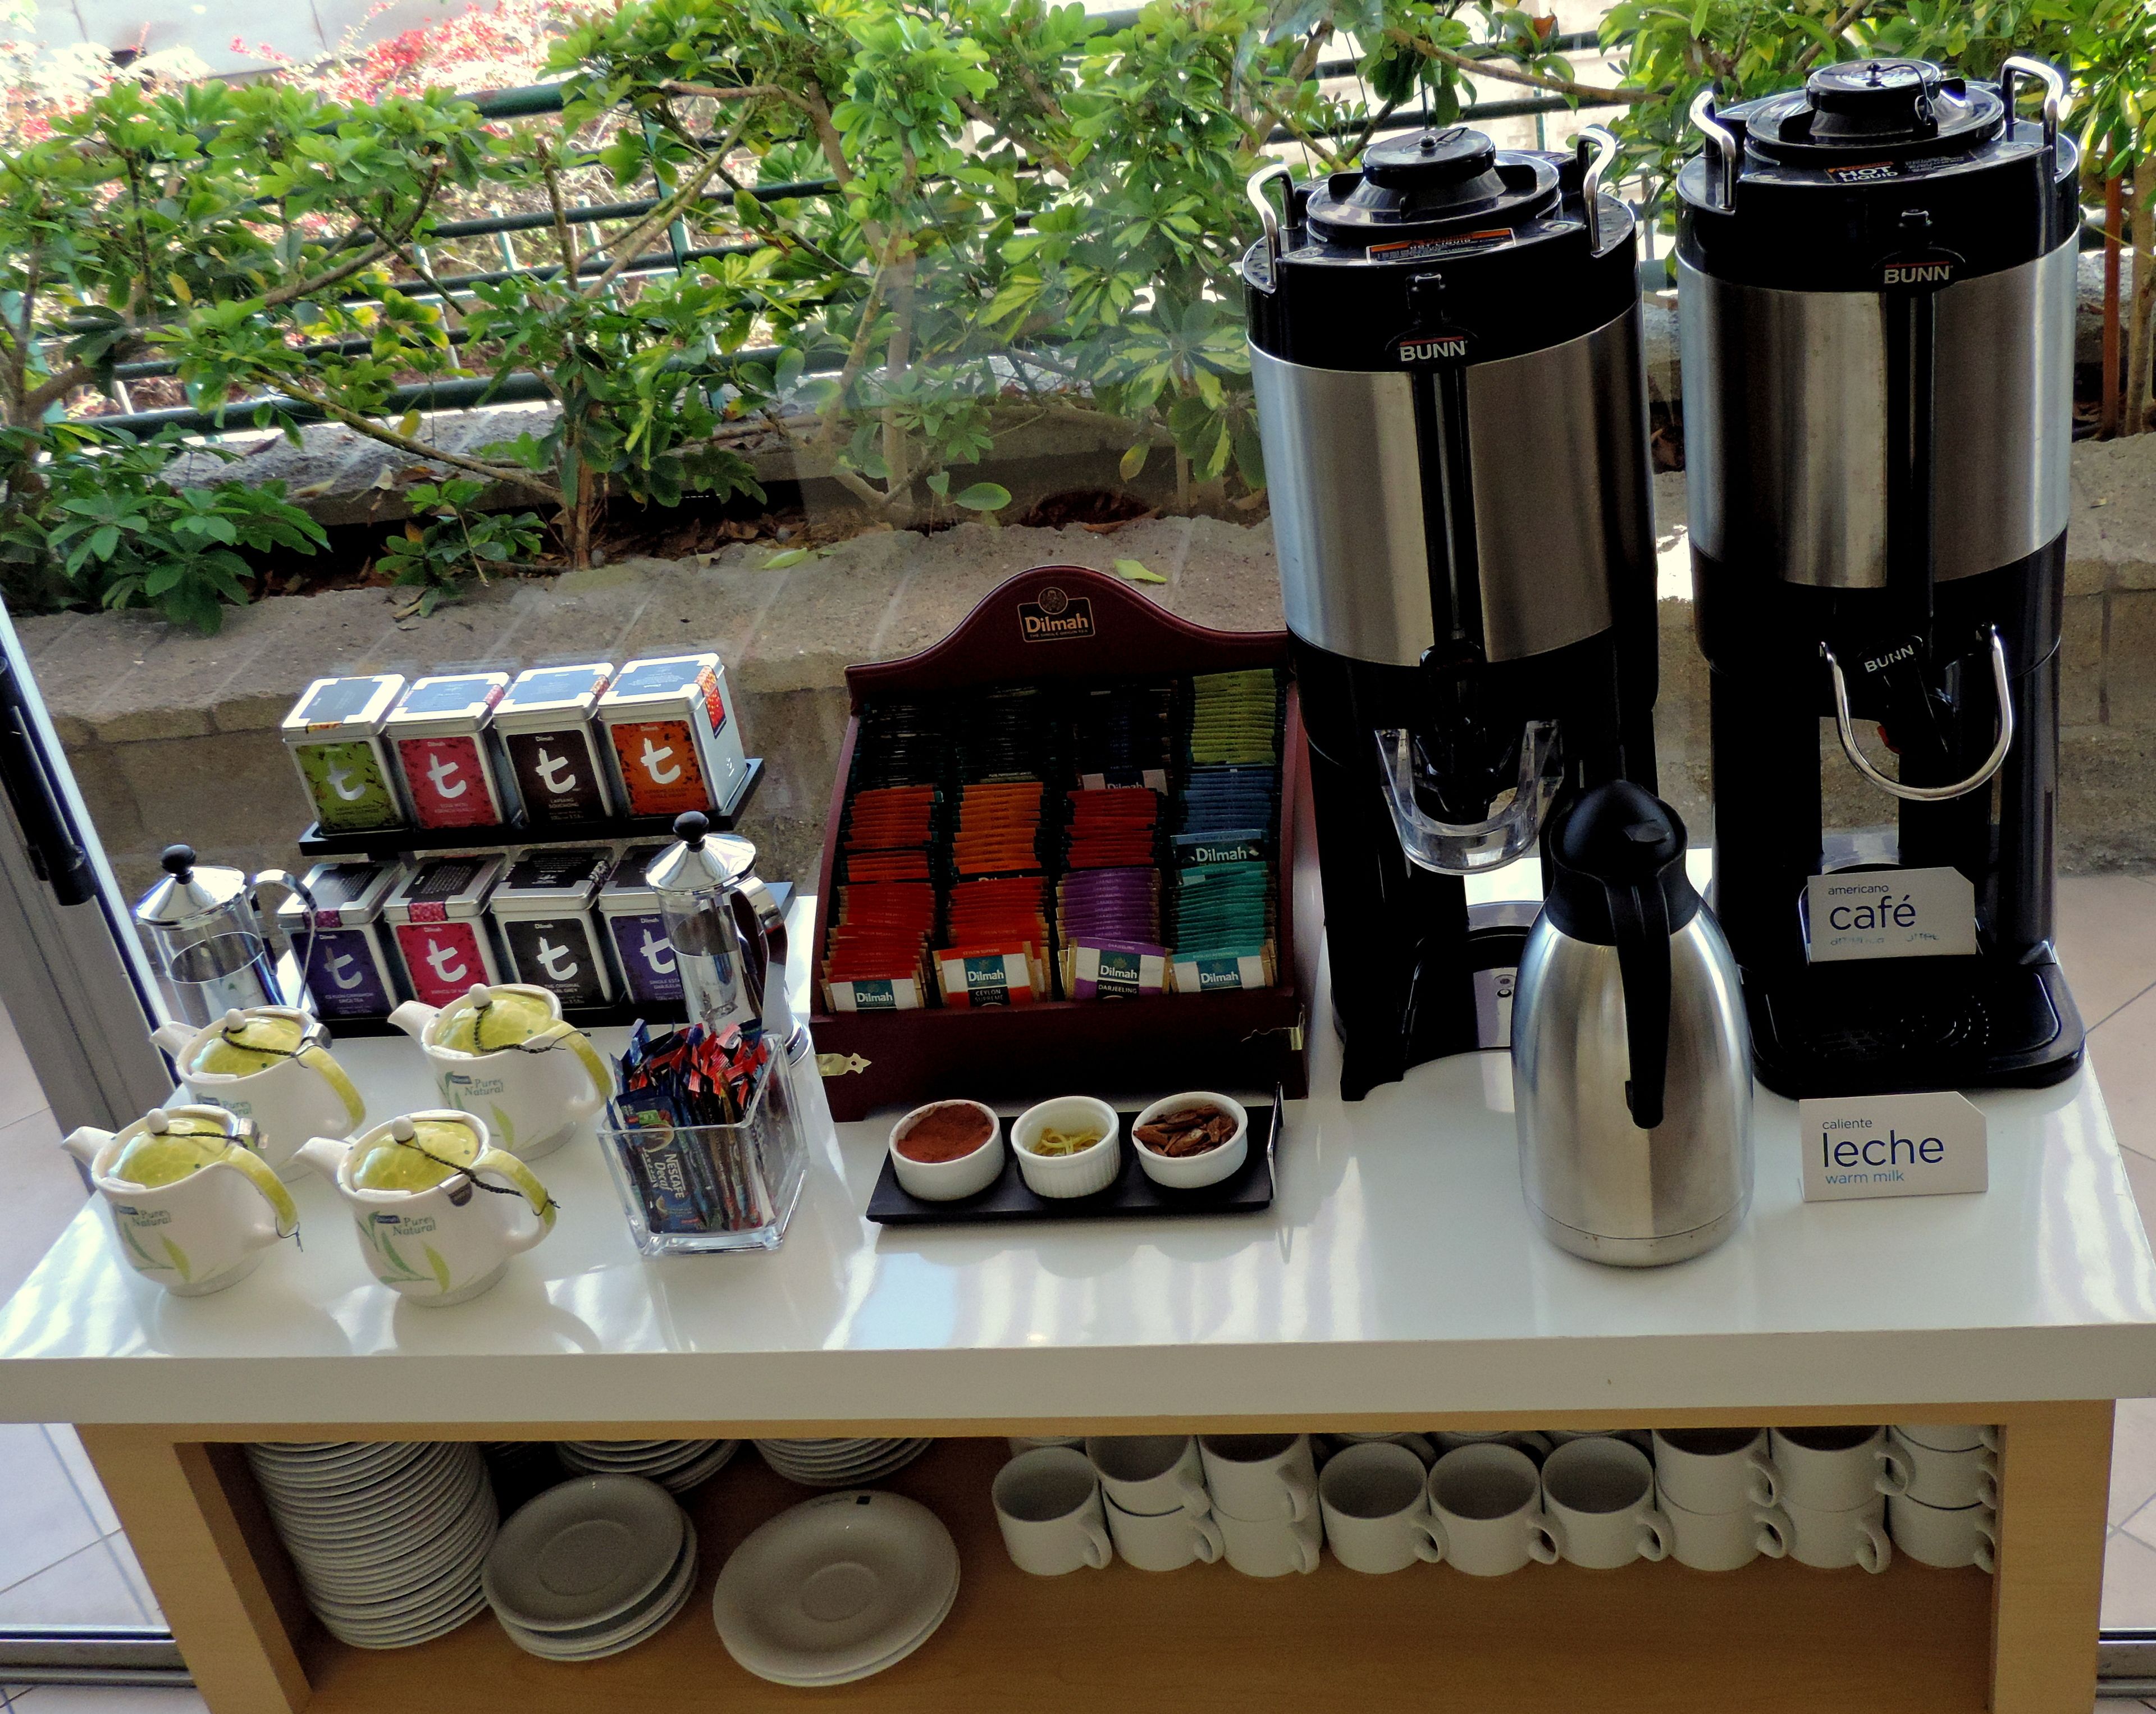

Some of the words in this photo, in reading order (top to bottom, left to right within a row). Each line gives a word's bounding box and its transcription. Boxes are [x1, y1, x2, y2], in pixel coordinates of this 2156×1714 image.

[1838, 166, 1891, 178] HOT
[1843, 172, 1898, 182] LIQUID
[1884, 265, 1949, 284] BUNN
[1400, 340, 1465, 362] BUNN
[1025, 613, 1089, 633] Dilmah
[1863, 645, 1914, 673] BUNN
[427, 753, 467, 798] t
[535, 747, 576, 794] t
[1195, 846, 1247, 862] Dilmah
[1828, 884, 1889, 895] americano
[1829, 894, 1916, 930] café
[426, 938, 467, 982] t
[536, 936, 578, 981] t
[967, 969, 1004, 982] Dilmah
[1100, 965, 1138, 979] Dilmah
[1200, 971, 1239, 984] Dilmah
[856, 991, 893, 1003] Dilmah
[1098, 984, 1137, 994] DARJEELING
[975, 994, 1004, 1003] SUPREME
[465, 1082, 504, 1096] Natural
[1822, 1118, 1872, 1130] caliente
[1822, 1129, 1944, 1168] leche
[654, 1162, 673, 1192] Decaf
[1825, 1172, 1869, 1184] warm
[1873, 1169, 1904, 1183] milk
[393, 1219, 436, 1236] Natural
